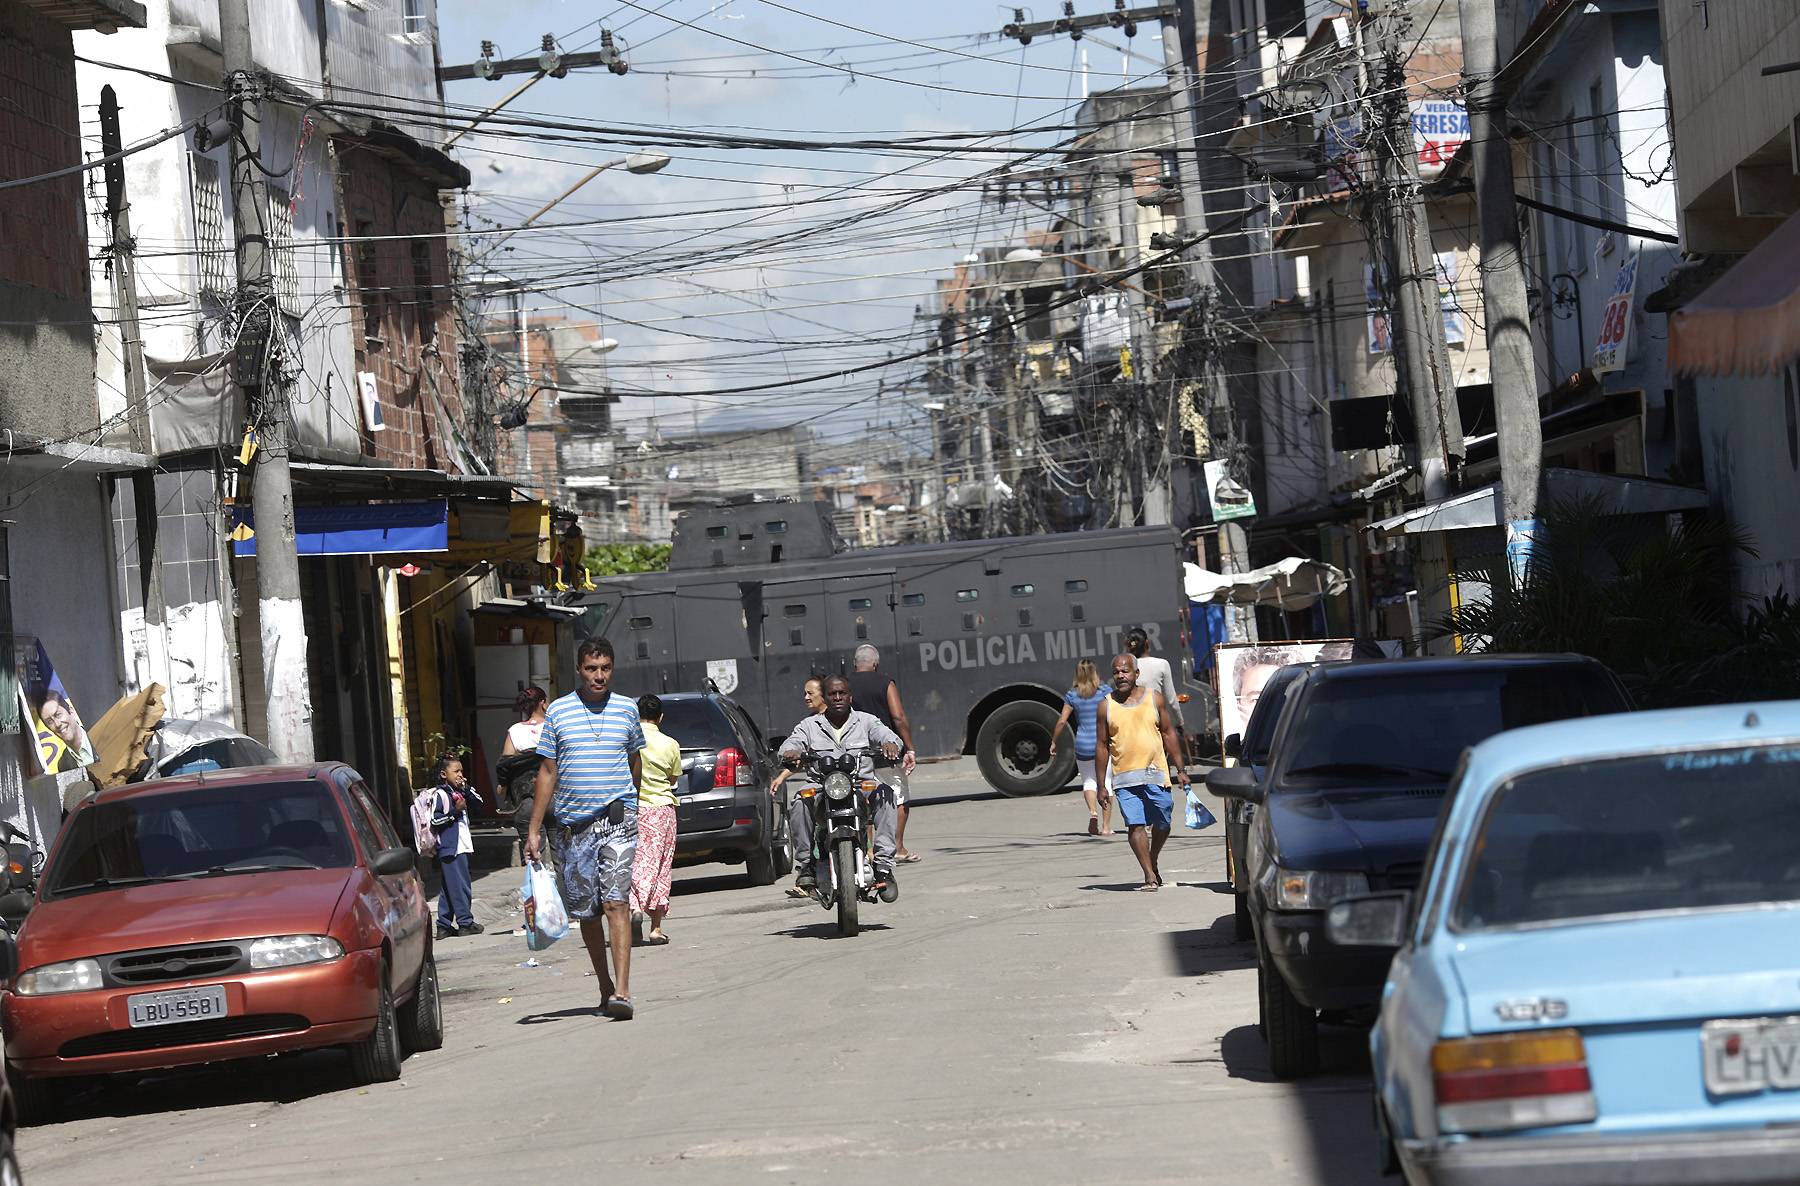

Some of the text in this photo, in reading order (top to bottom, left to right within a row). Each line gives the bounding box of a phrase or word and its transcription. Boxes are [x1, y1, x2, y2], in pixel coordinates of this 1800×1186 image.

[1425, 103, 1467, 112] VEREA
[919, 622, 1164, 672] POLICIA MILITR
